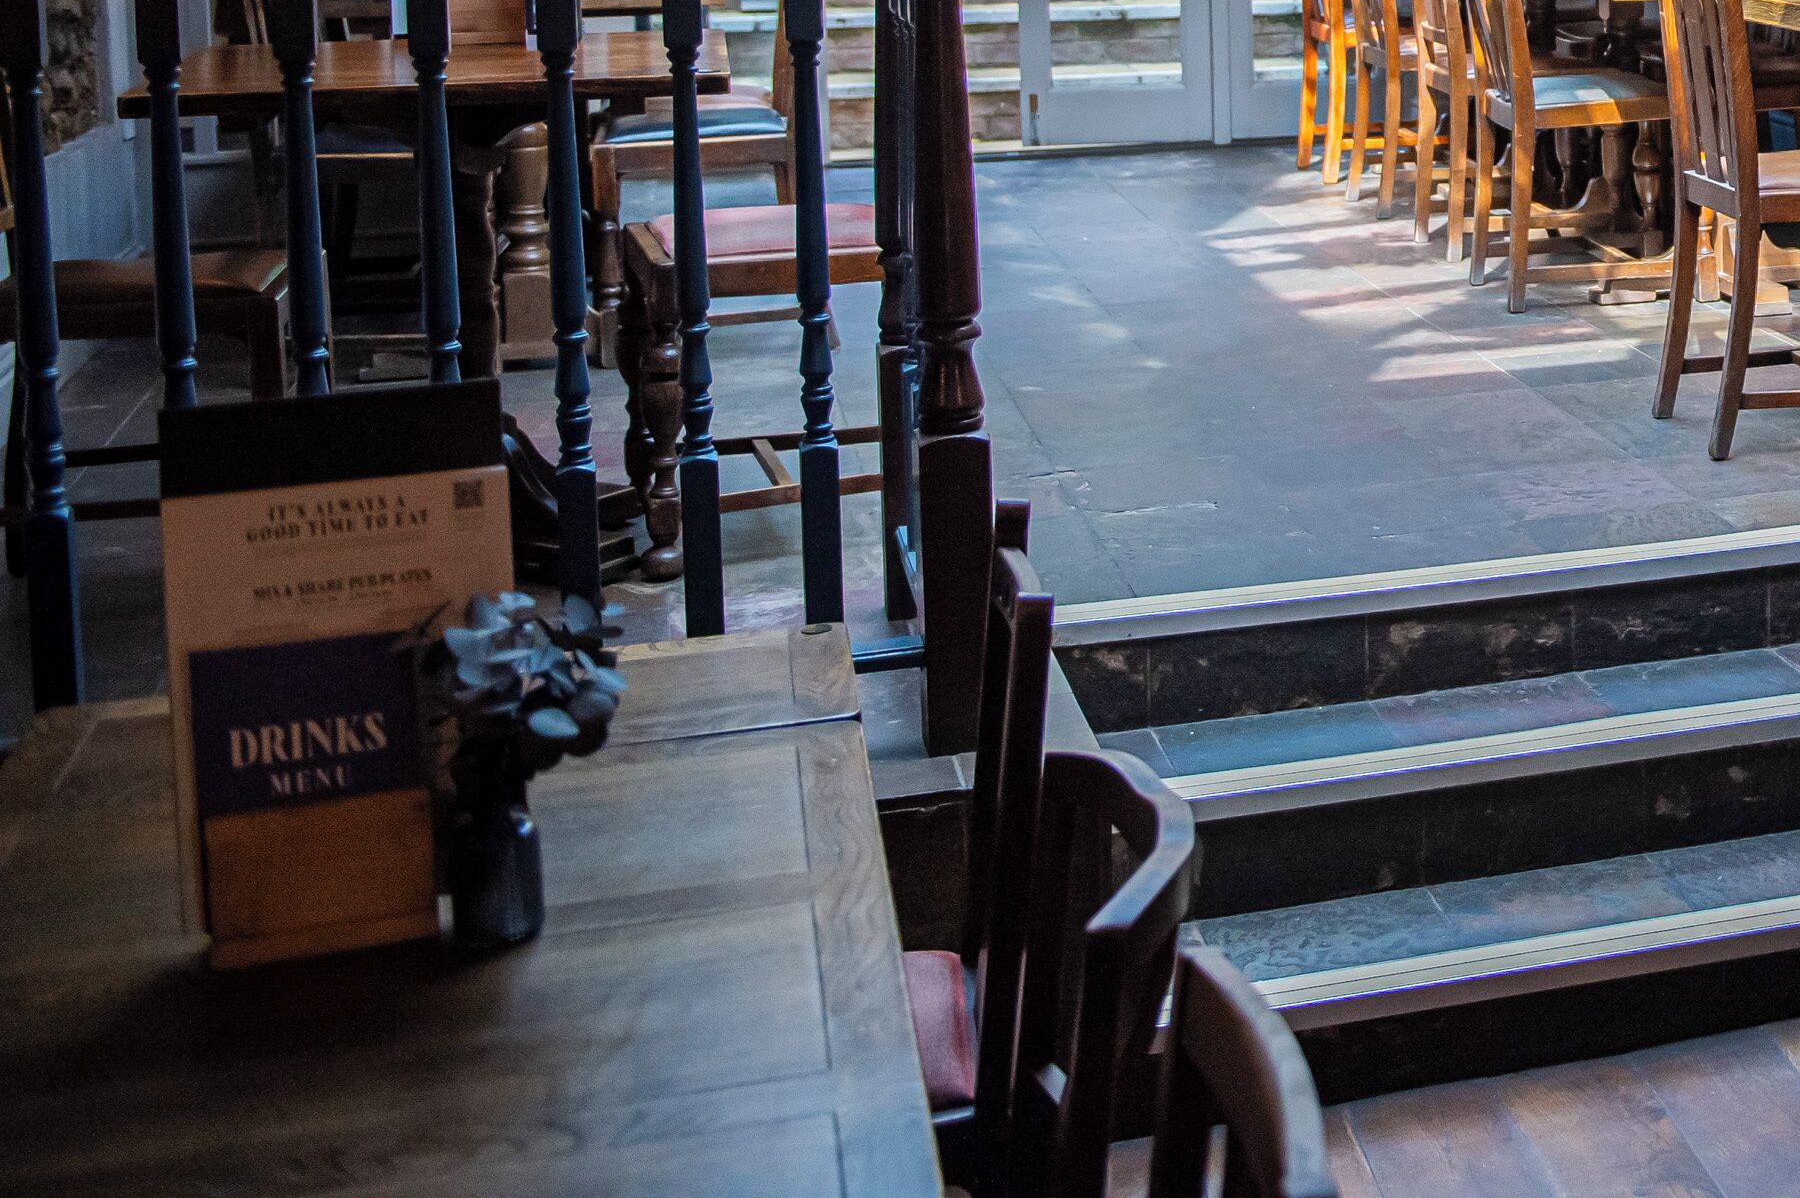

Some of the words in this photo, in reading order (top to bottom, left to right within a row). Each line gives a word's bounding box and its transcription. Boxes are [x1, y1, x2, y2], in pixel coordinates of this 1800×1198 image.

[364, 513, 388, 530] TO
[229, 711, 388, 769] DRINKS
[270, 765, 352, 796] MENU
